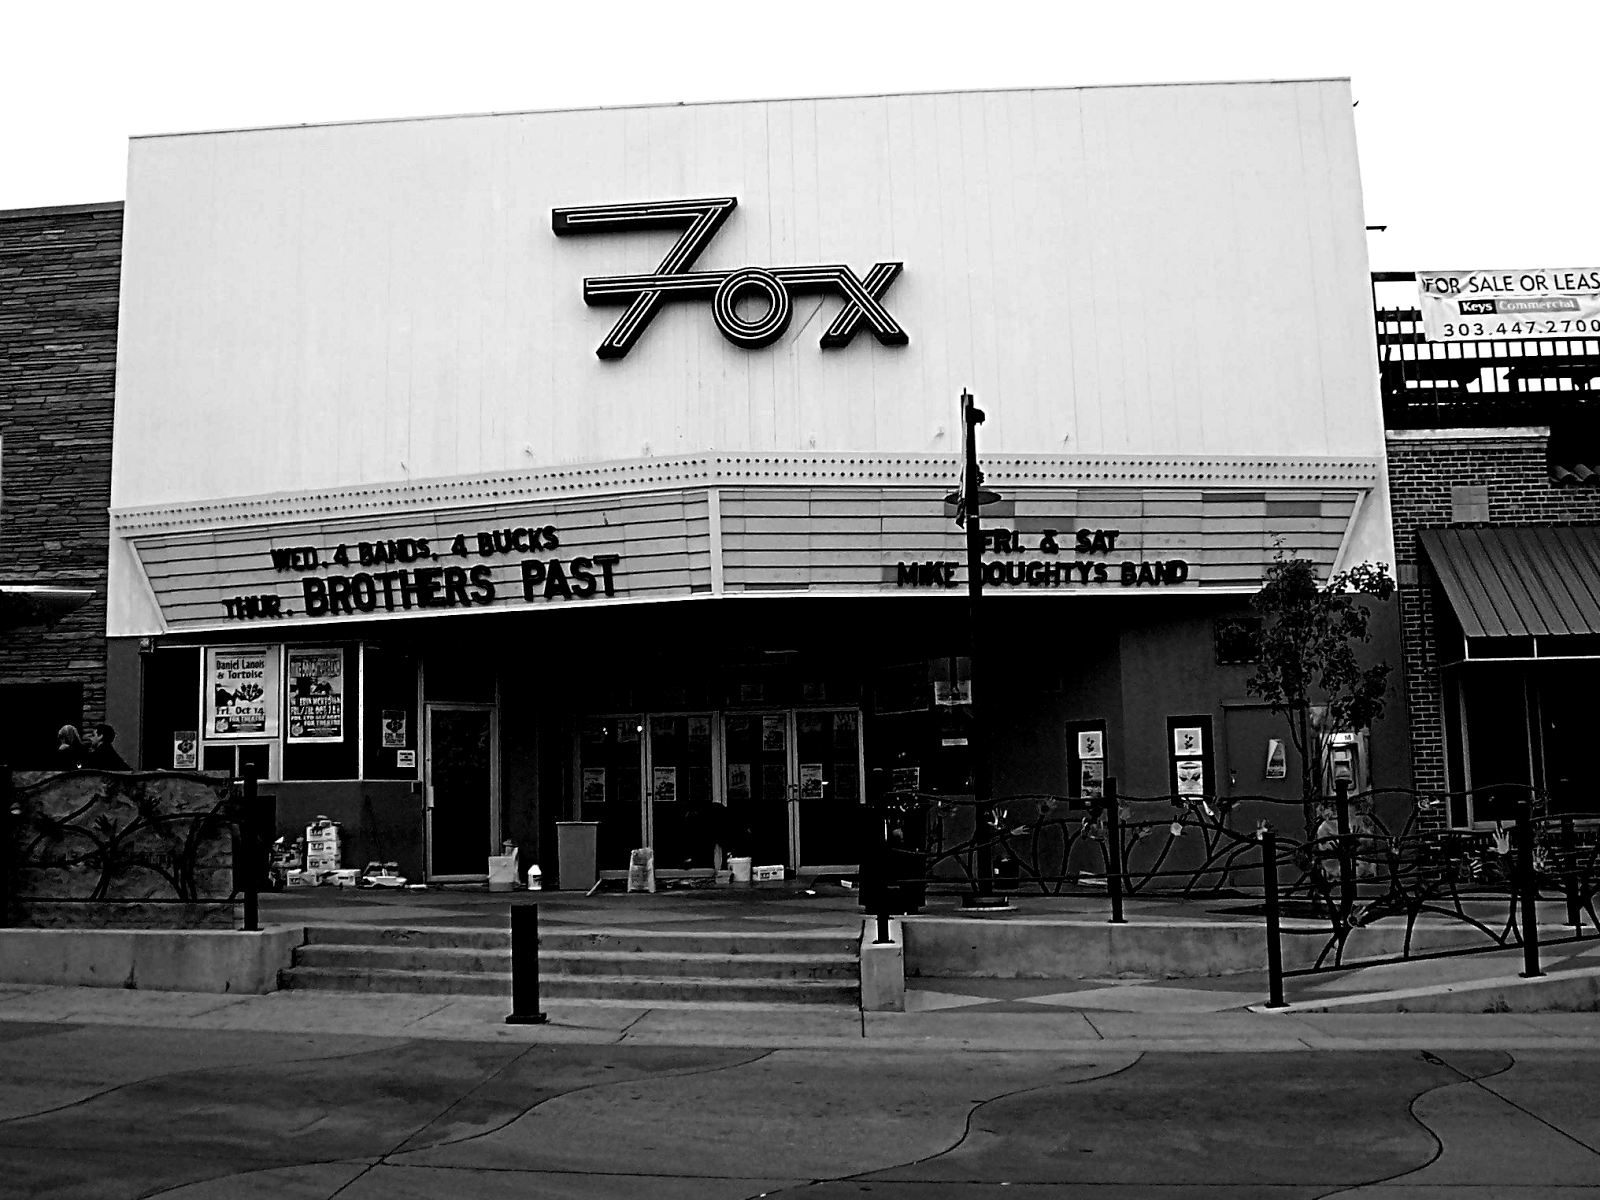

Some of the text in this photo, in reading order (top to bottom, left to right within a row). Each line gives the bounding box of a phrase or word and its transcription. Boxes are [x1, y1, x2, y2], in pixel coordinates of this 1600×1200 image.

[1424, 277, 1461, 293] FOR
[1469, 275, 1514, 293] SALE
[1520, 274, 1548, 291] OR
[1462, 302, 1493, 313] Keys
[333, 544, 349, 566] 4
[451, 533, 467, 557] 4
[478, 525, 560, 557] BUCKS
[1040, 530, 1059, 554] &
[1075, 529, 1119, 553] SAT
[897, 562, 959, 588] MIKE
[1121, 560, 1188, 586] BAND
[302, 564, 496, 617] BROTHERS
[521, 554, 620, 601] PAST
[217, 660, 239, 669] Daniel
[228, 670, 263, 679] Tortoise
[235, 706, 250, 714] Oct
